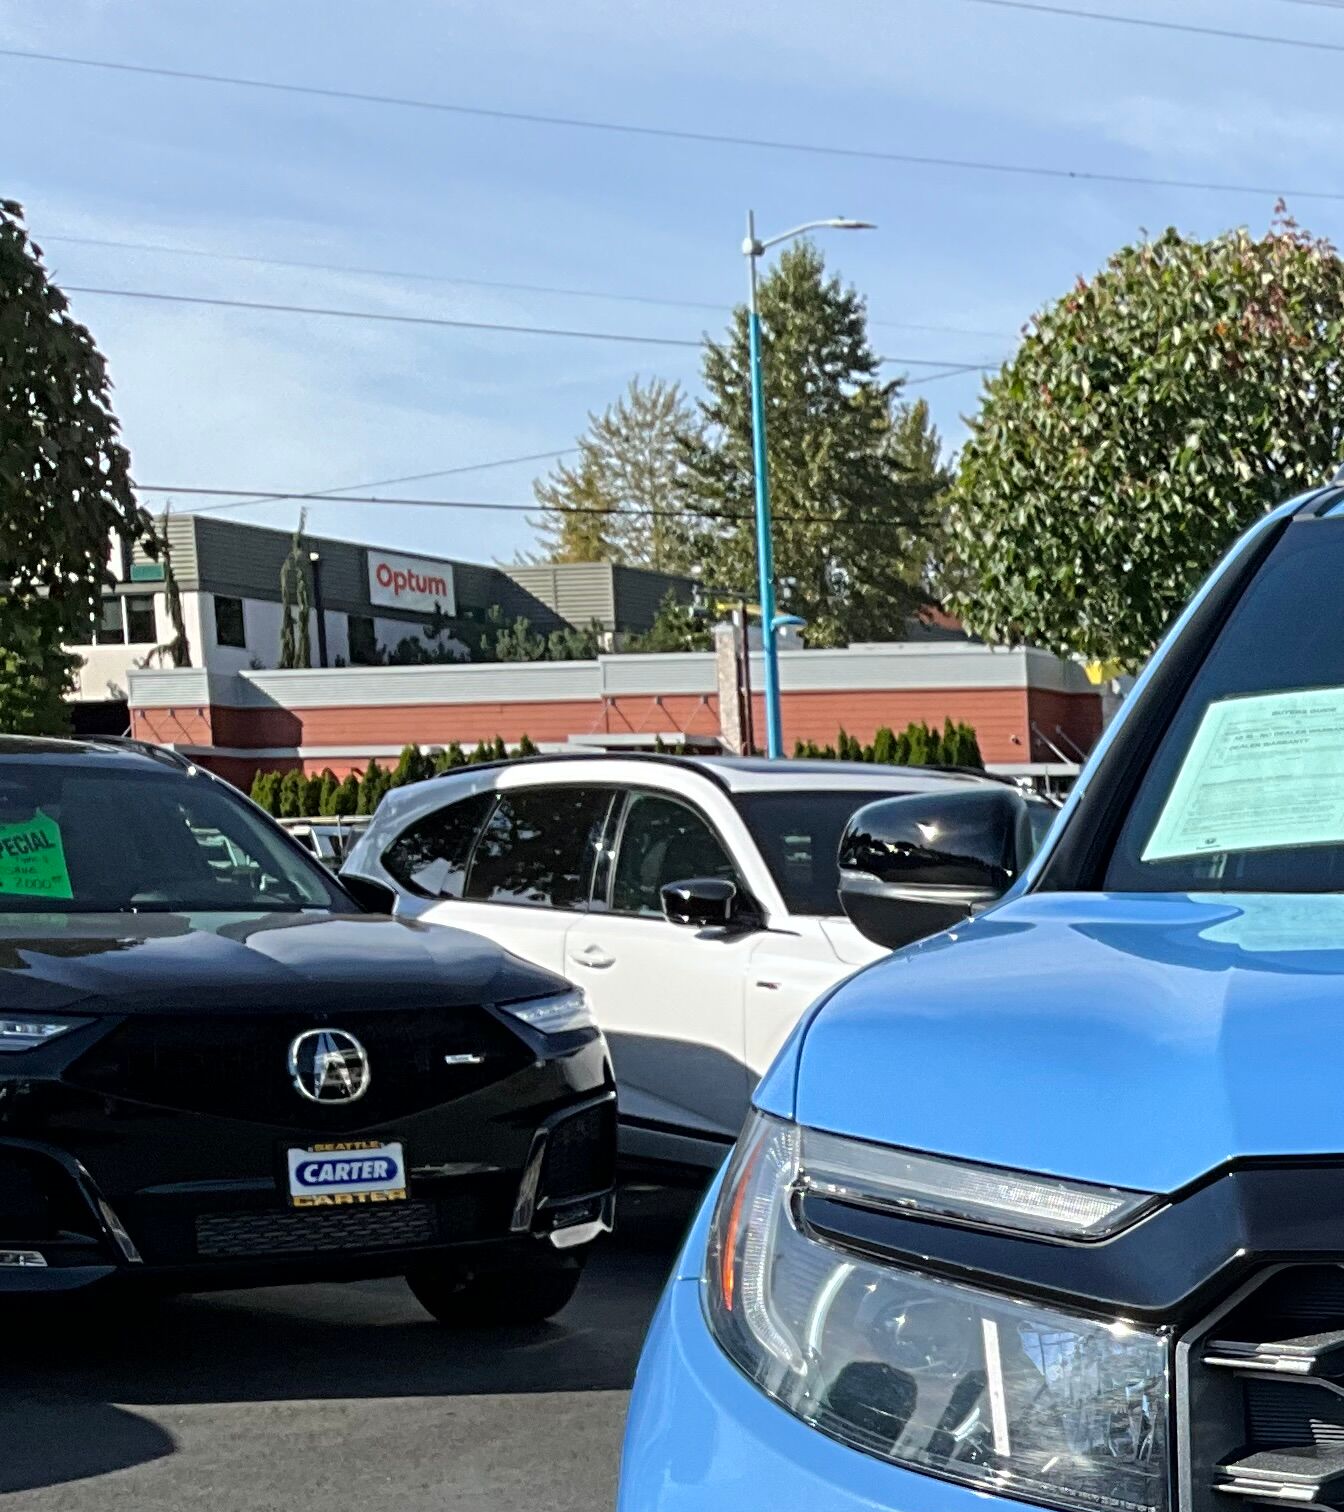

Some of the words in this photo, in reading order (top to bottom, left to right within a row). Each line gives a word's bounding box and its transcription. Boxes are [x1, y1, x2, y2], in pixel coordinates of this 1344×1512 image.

[376, 563, 447, 597] Optum
[0, 830, 56, 858] PECIAL
[314, 1141, 379, 1152] SEATTLE
[303, 1160, 388, 1183] CARTER
[293, 1188, 407, 1207] CARTER
